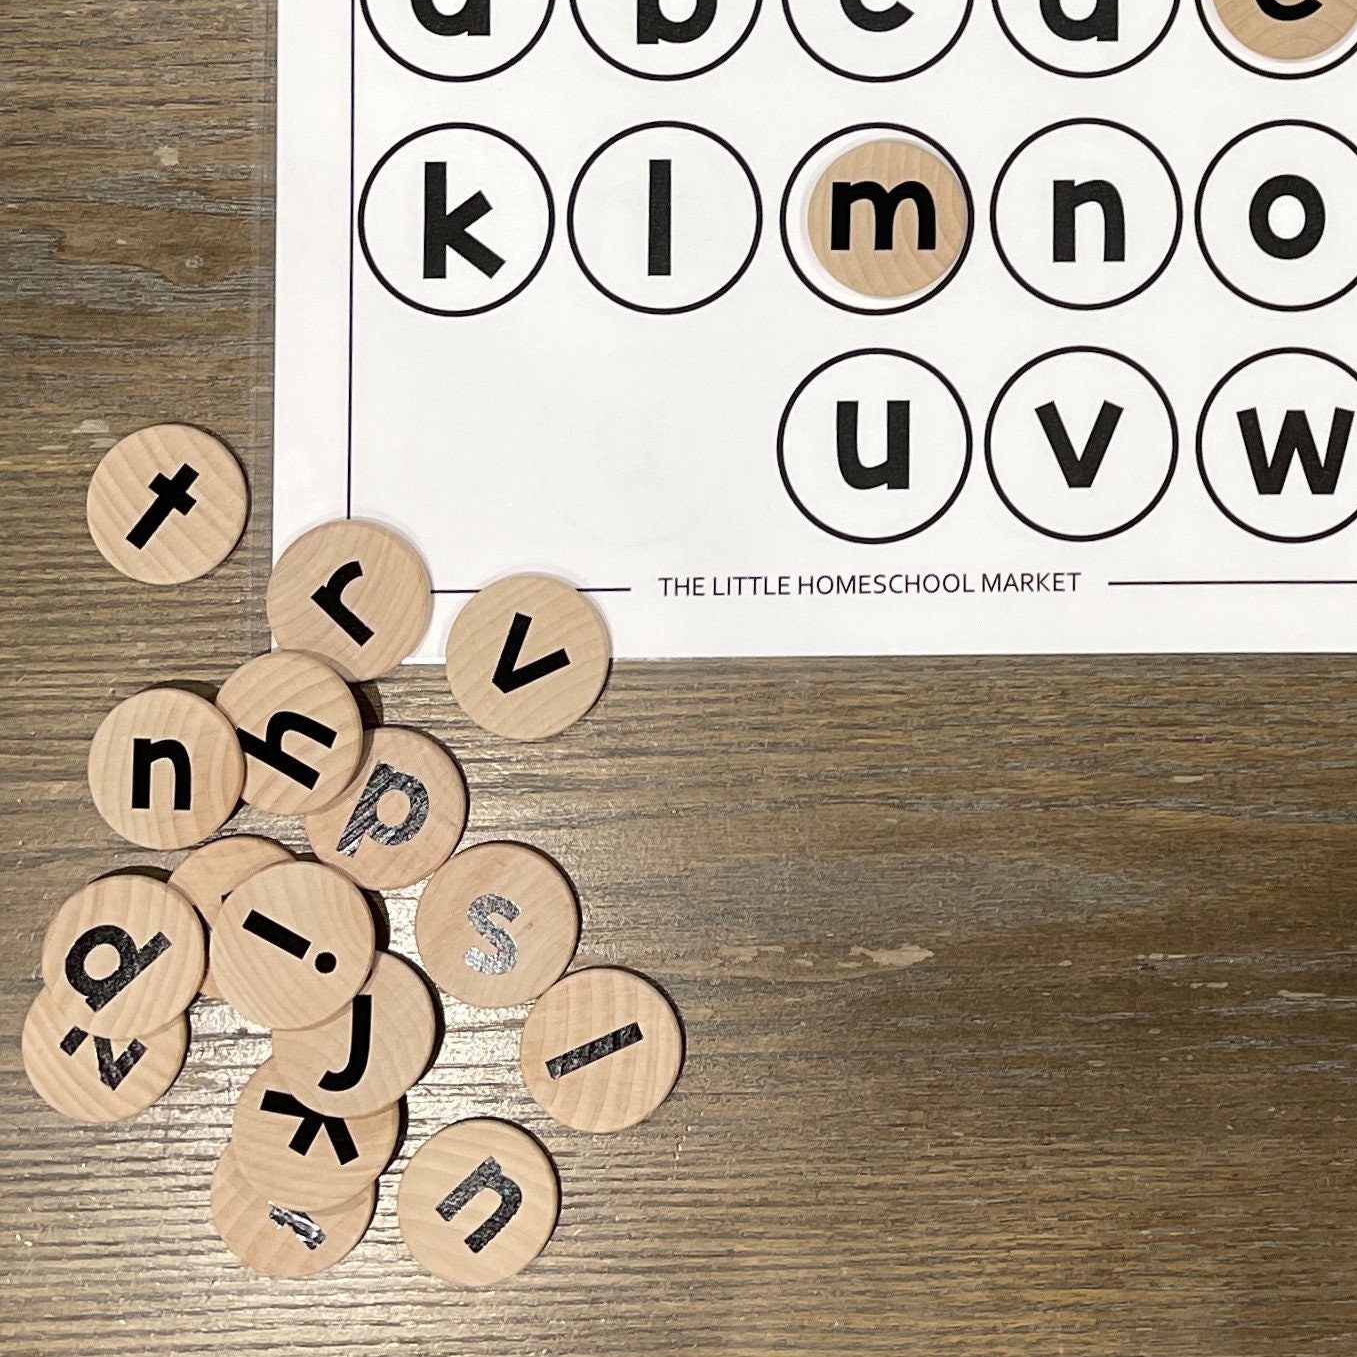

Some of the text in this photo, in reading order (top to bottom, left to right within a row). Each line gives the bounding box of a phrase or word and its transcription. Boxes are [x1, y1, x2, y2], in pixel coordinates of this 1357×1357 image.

[424, 160, 1325, 278] k l m n o
[837, 401, 1354, 494] u v w
[126, 464, 199, 549] t
[311, 561, 374, 647] r
[658, 573, 1081, 596] THE LITTLE HOMESCHOOL MARKET
[492, 613, 570, 693] v
[132, 738, 191, 810] n
[236, 711, 337, 791] h
[462, 892, 523, 976] s
